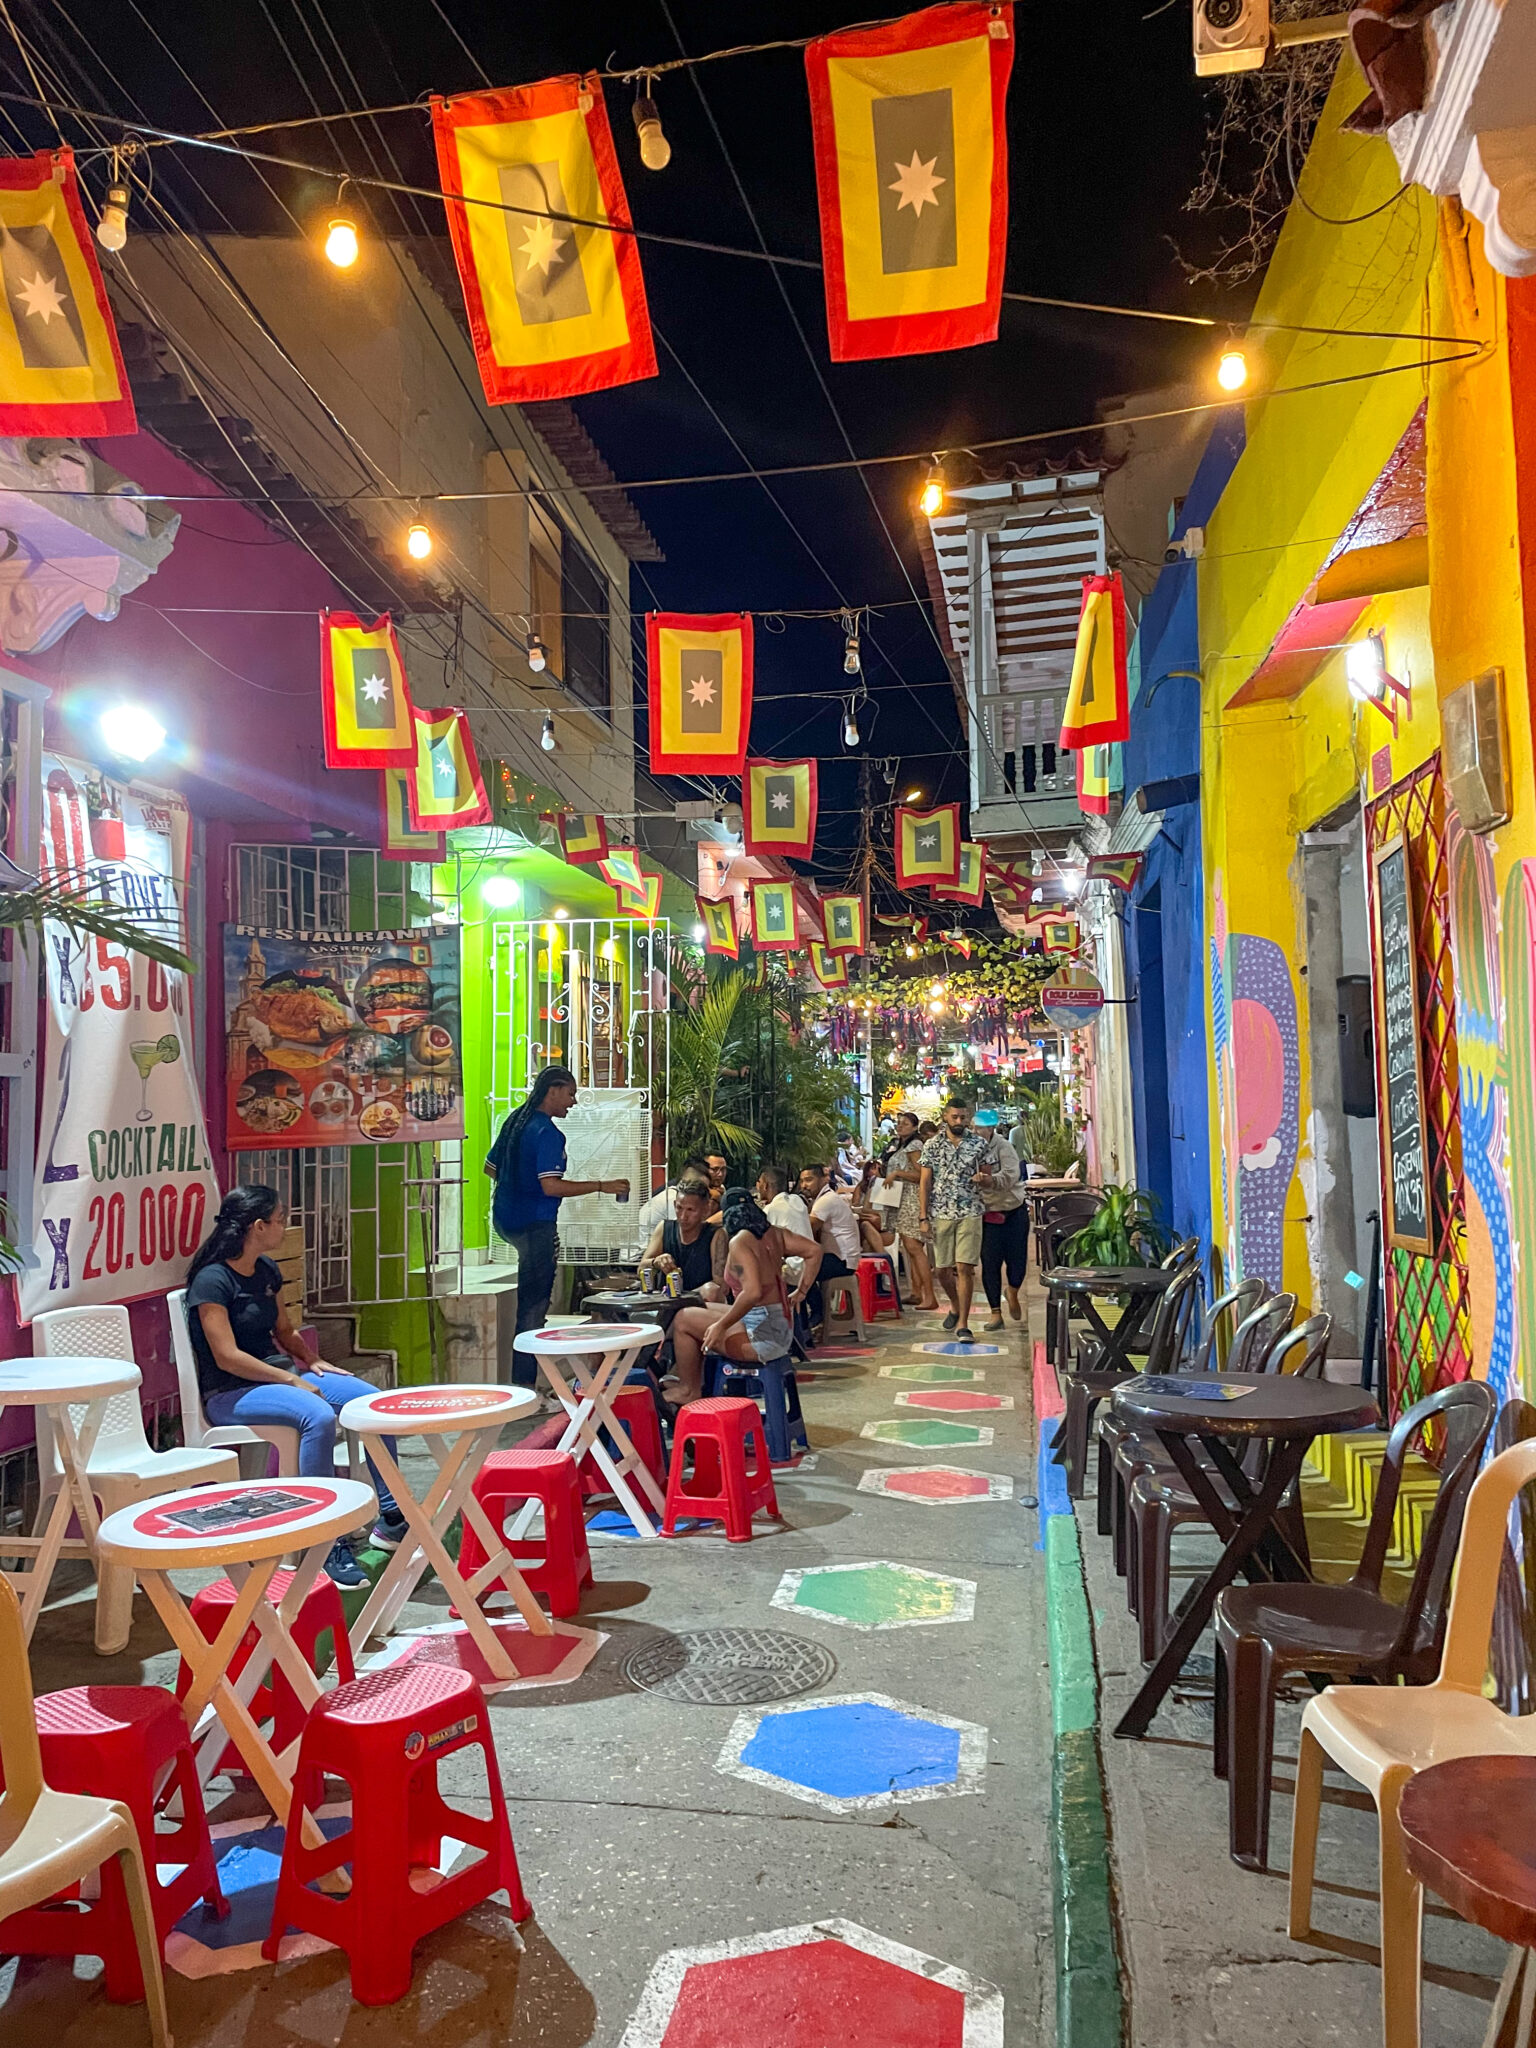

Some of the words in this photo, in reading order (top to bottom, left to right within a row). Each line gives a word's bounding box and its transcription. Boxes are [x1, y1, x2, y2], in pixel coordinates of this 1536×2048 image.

[236, 924, 449, 943] RESTAURANTE
[42, 1218, 71, 1290] X
[82, 1182, 206, 1281] 20.000
